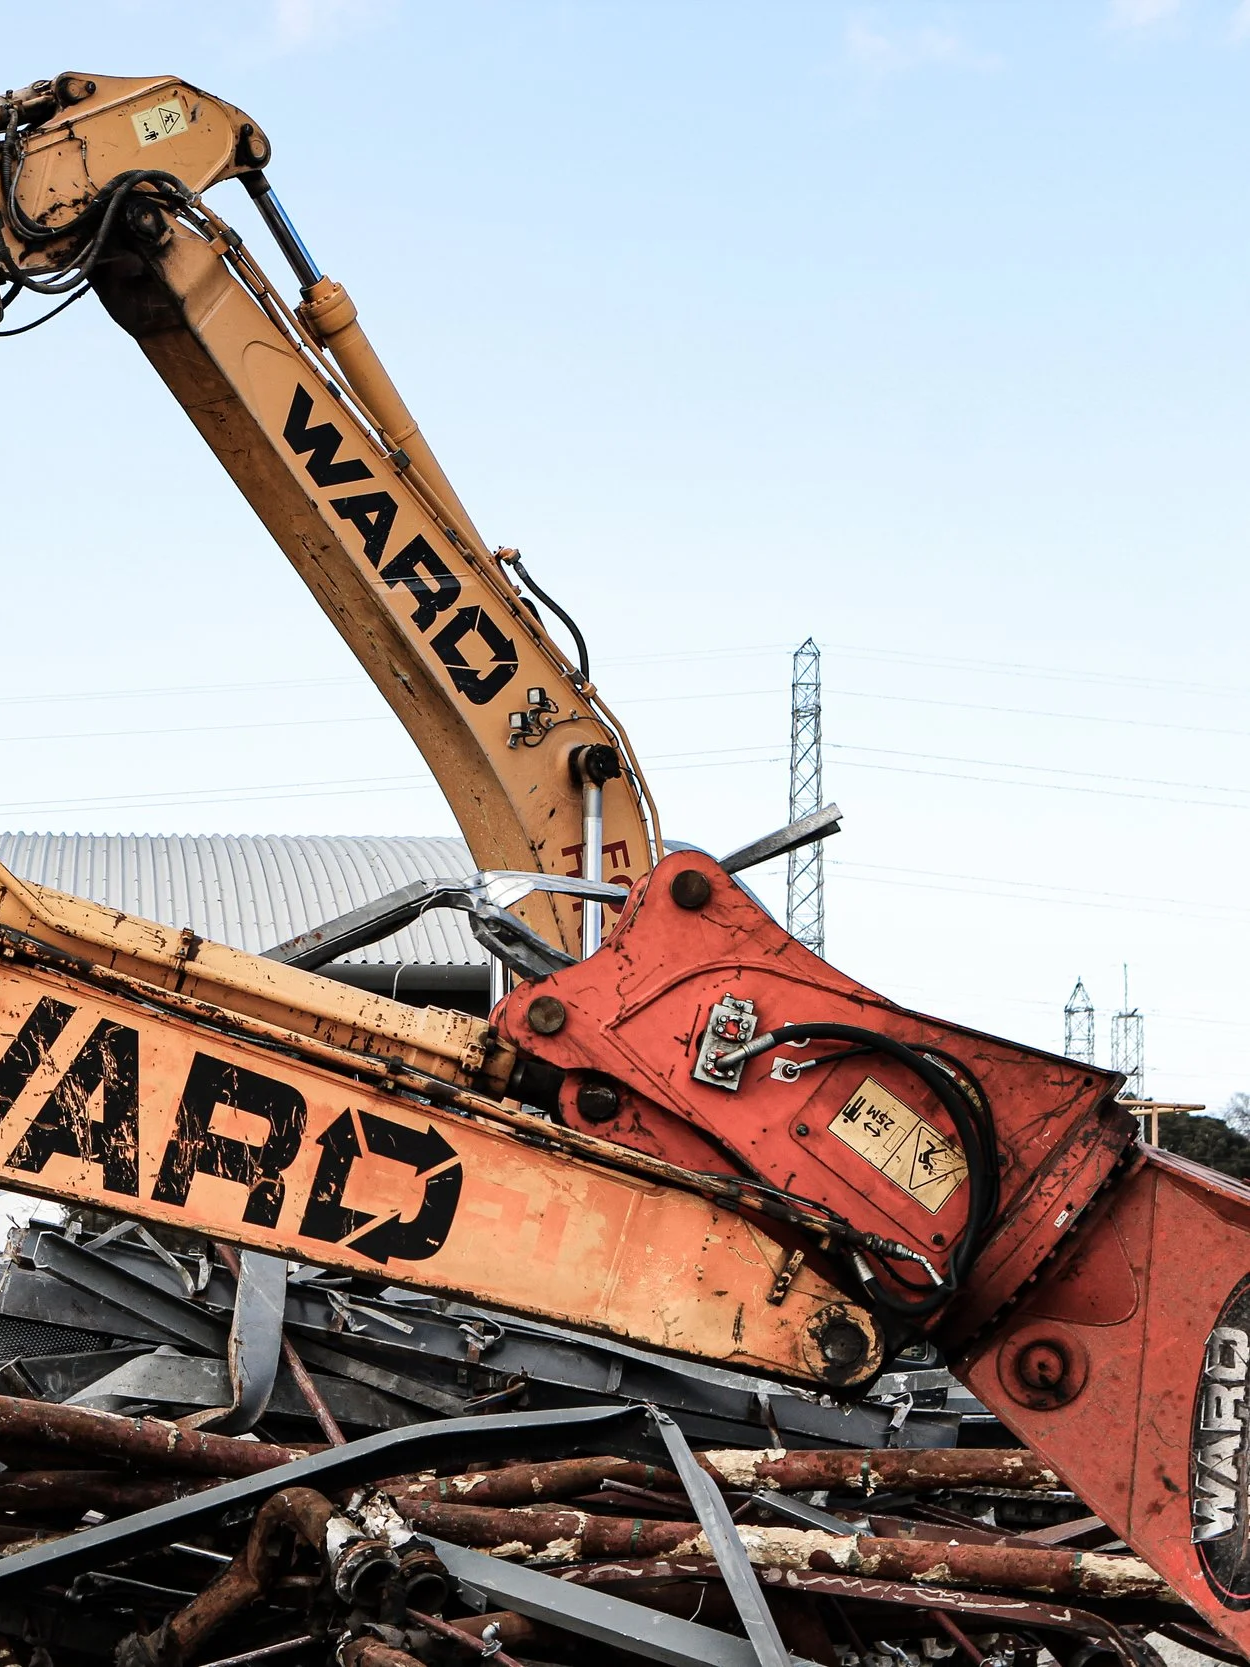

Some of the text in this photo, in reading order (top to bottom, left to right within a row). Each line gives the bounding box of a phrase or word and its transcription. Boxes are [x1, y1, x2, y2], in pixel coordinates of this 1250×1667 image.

[283, 381, 519, 705] WARD
[866, 1104, 896, 1131] 25M
[1190, 1326, 1250, 1544] WARD
